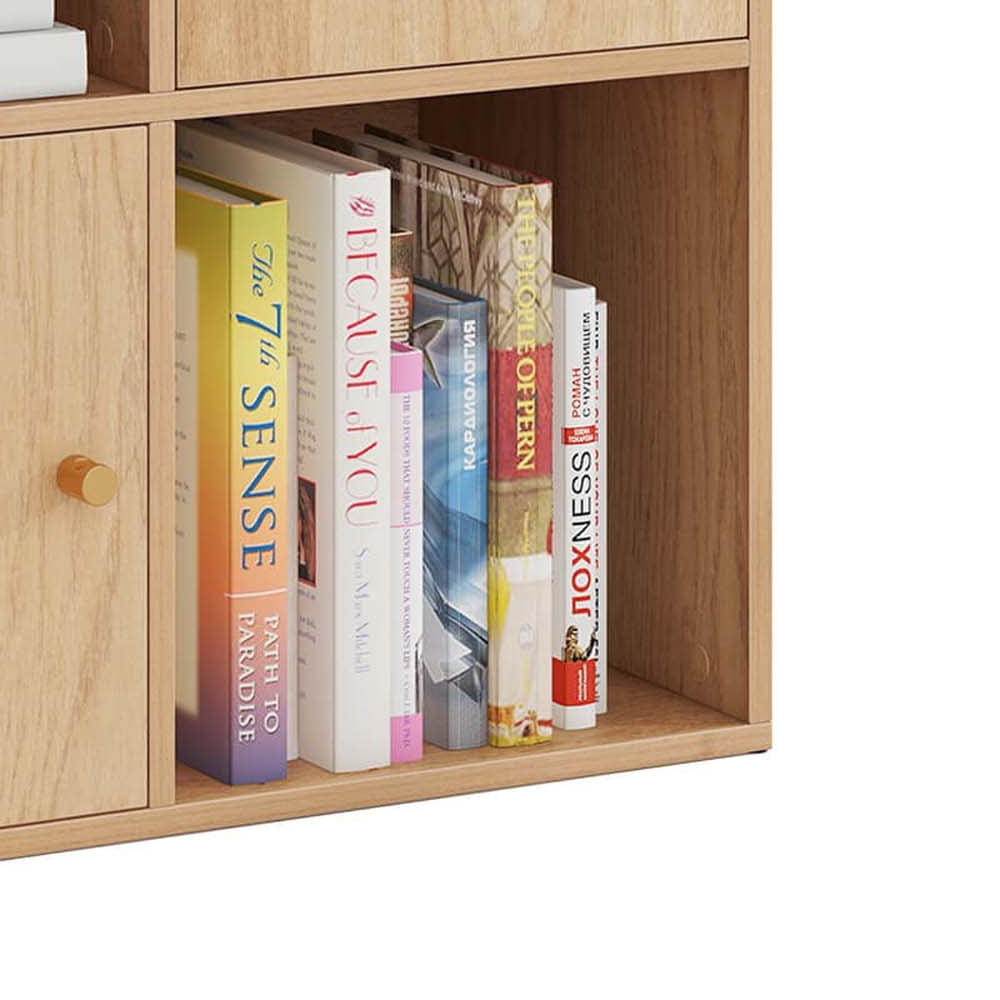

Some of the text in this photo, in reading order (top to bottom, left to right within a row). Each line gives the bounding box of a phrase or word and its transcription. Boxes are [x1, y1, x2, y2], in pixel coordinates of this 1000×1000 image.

[251, 243, 274, 298] The
[345, 228, 378, 400] BECAUSE
[463, 319, 477, 471] КАРДИОЛОГИЯ
[516, 357, 537, 395] OF
[571, 367, 582, 419] РОМАН
[241, 385, 277, 570] SENSE
[345, 441, 378, 527] YOU
[516, 397, 537, 470] PERN
[237, 611, 257, 744] PARADISE
[262, 616, 281, 735] PATH TO
